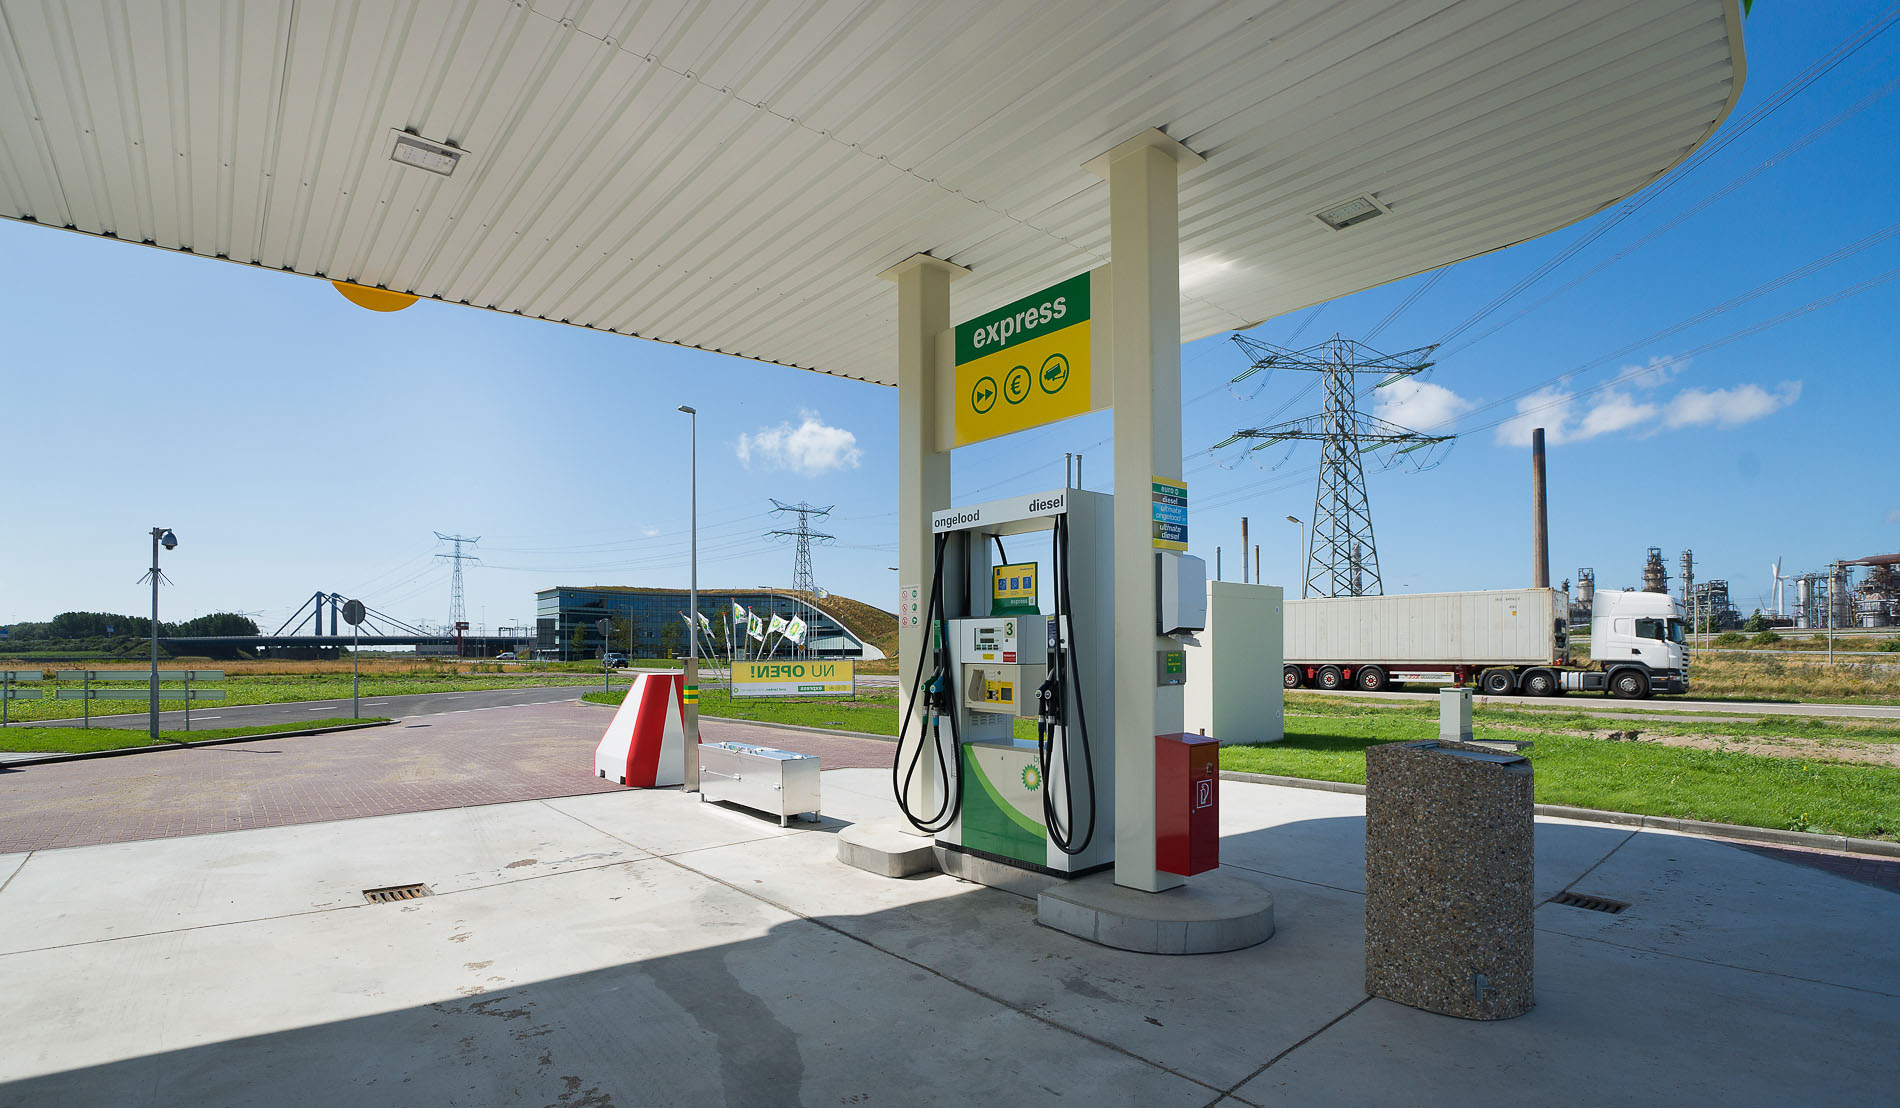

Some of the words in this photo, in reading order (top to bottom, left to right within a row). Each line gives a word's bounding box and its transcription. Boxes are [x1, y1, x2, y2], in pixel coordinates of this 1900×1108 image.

[973, 296, 1067, 349] express
[1029, 494, 1064, 513] diesel
[1162, 496, 1178, 504] diesel
[934, 509, 980, 529] ongelood
[1160, 524, 1181, 533] ultimate
[1161, 532, 1180, 540] diesel
[1006, 622, 1013, 636] 3
